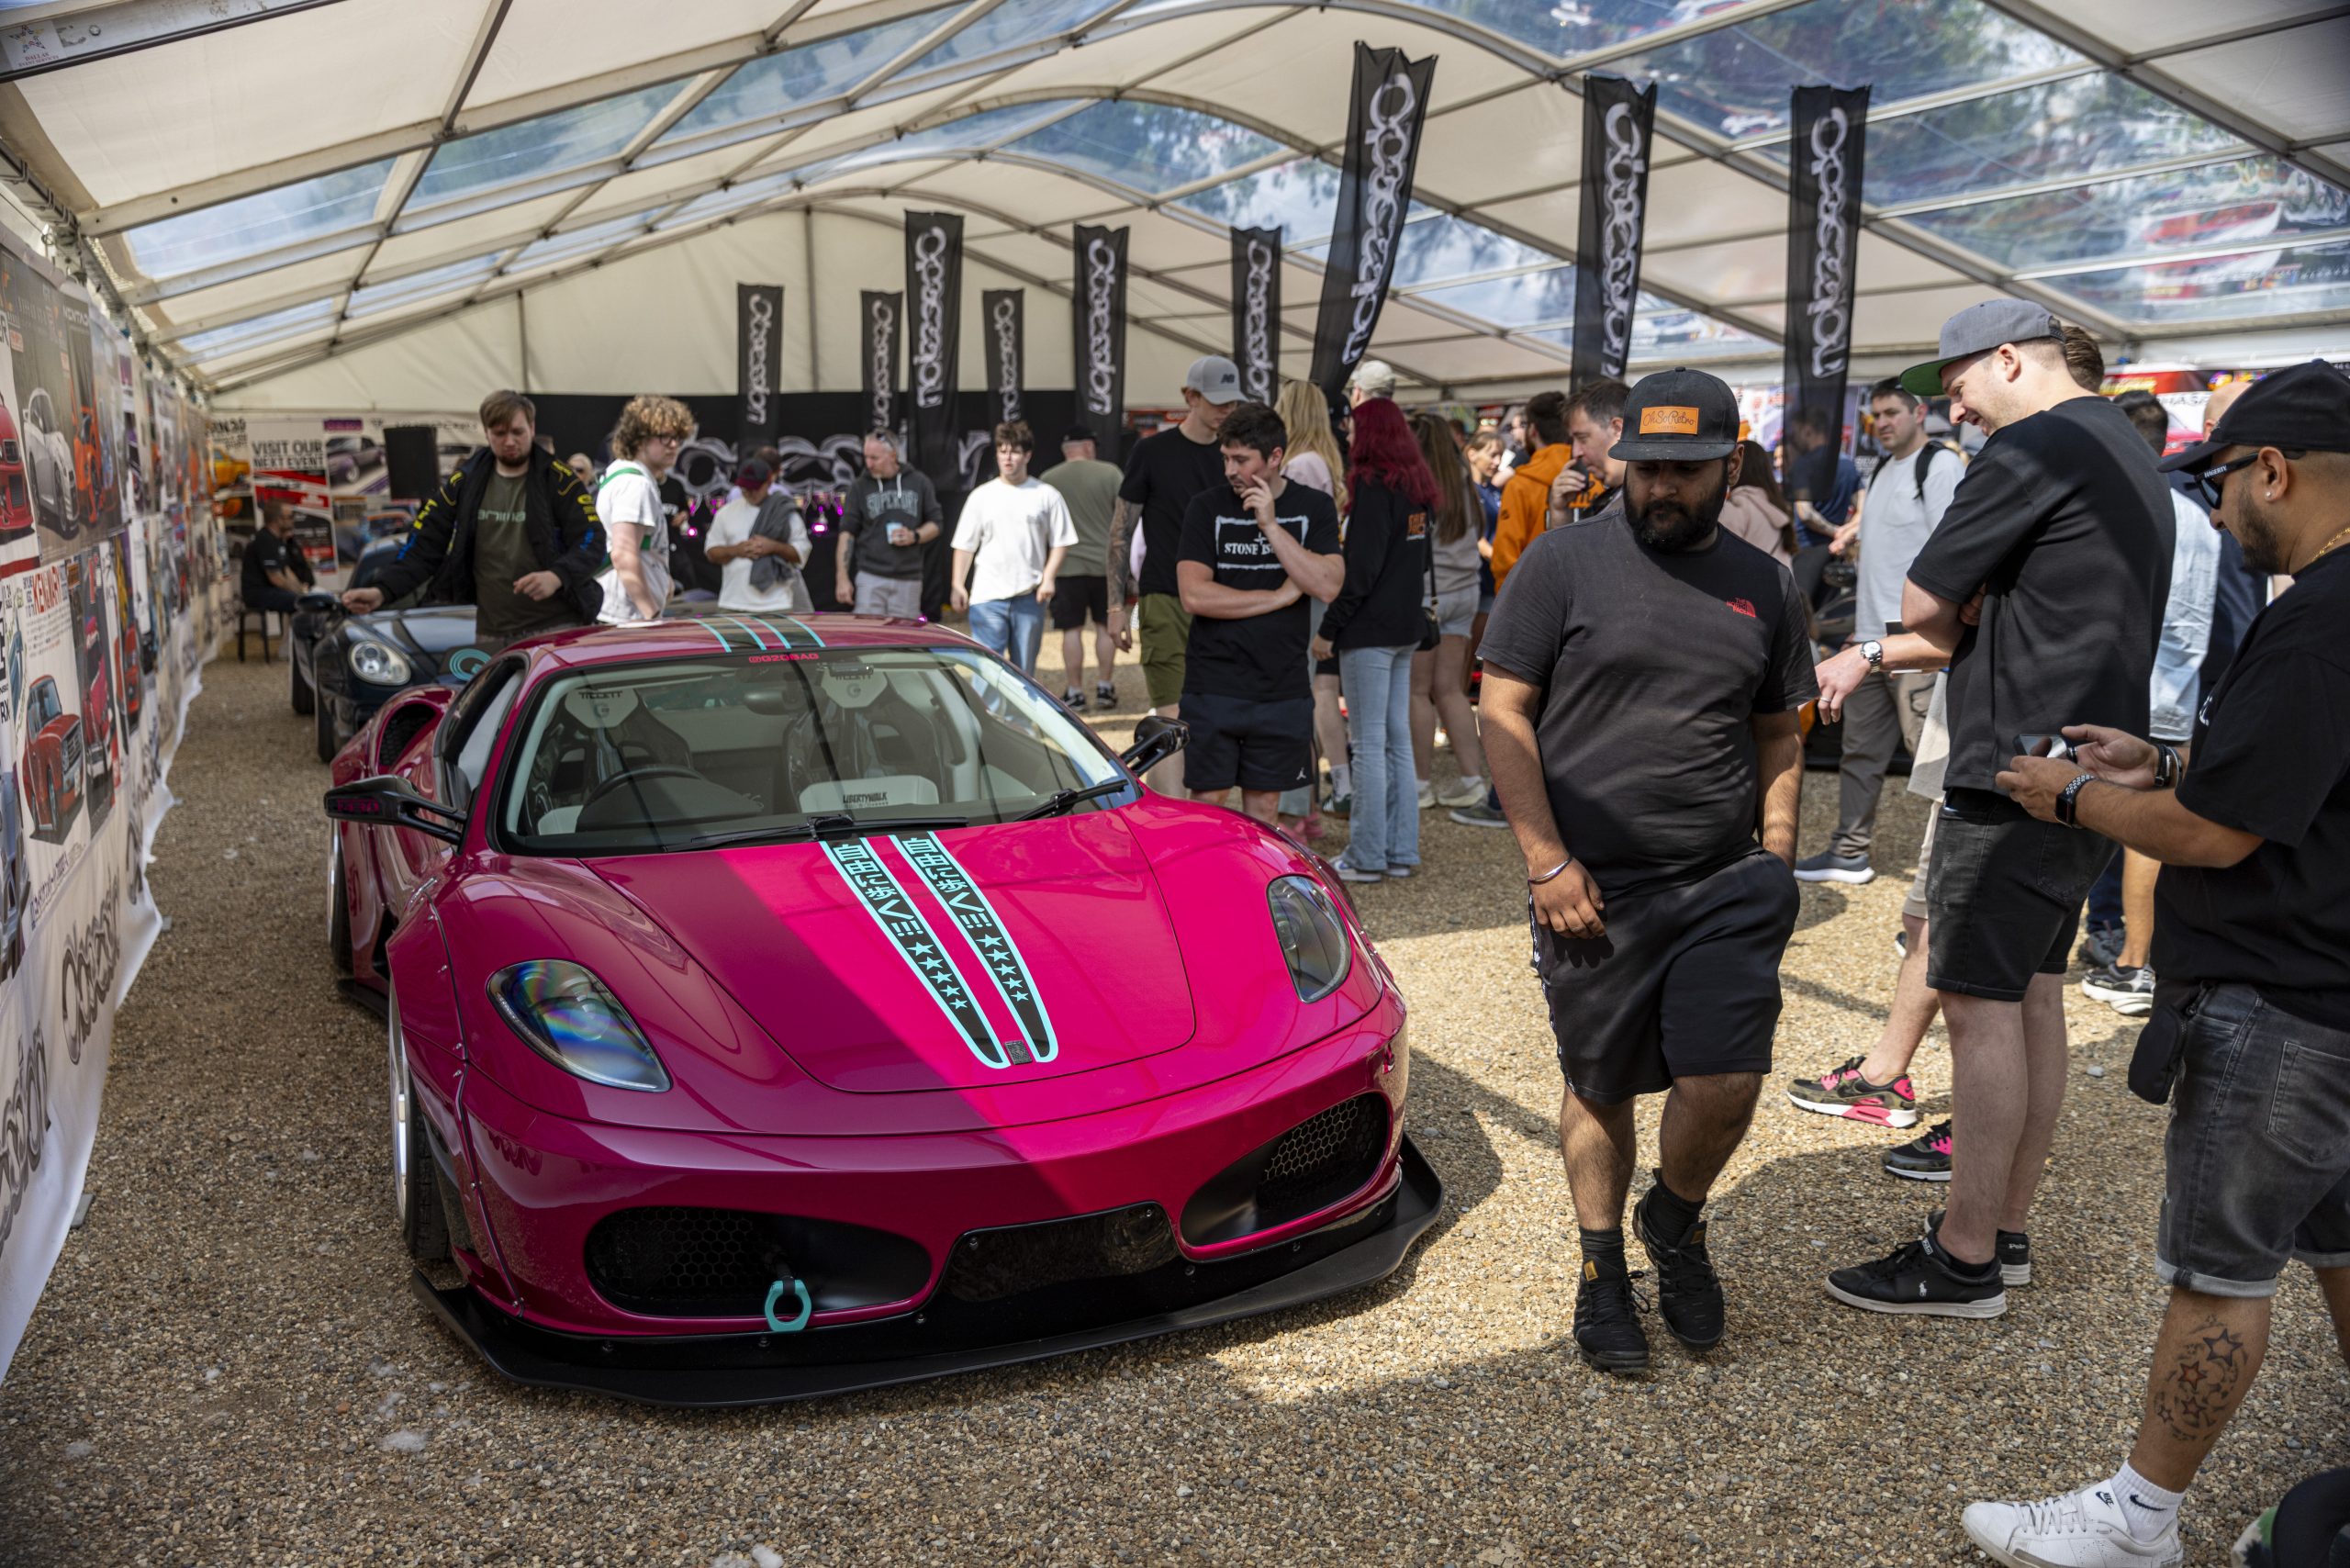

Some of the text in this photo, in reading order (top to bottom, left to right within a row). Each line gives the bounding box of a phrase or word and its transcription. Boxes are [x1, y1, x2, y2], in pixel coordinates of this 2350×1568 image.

[252, 440, 287, 455] VISIT
[292, 440, 323, 455] OUR
[253, 456, 323, 467] NEXT EVENT
[2204, 465, 2227, 477] HAGERTY
[1224, 543, 1258, 555] STONE
